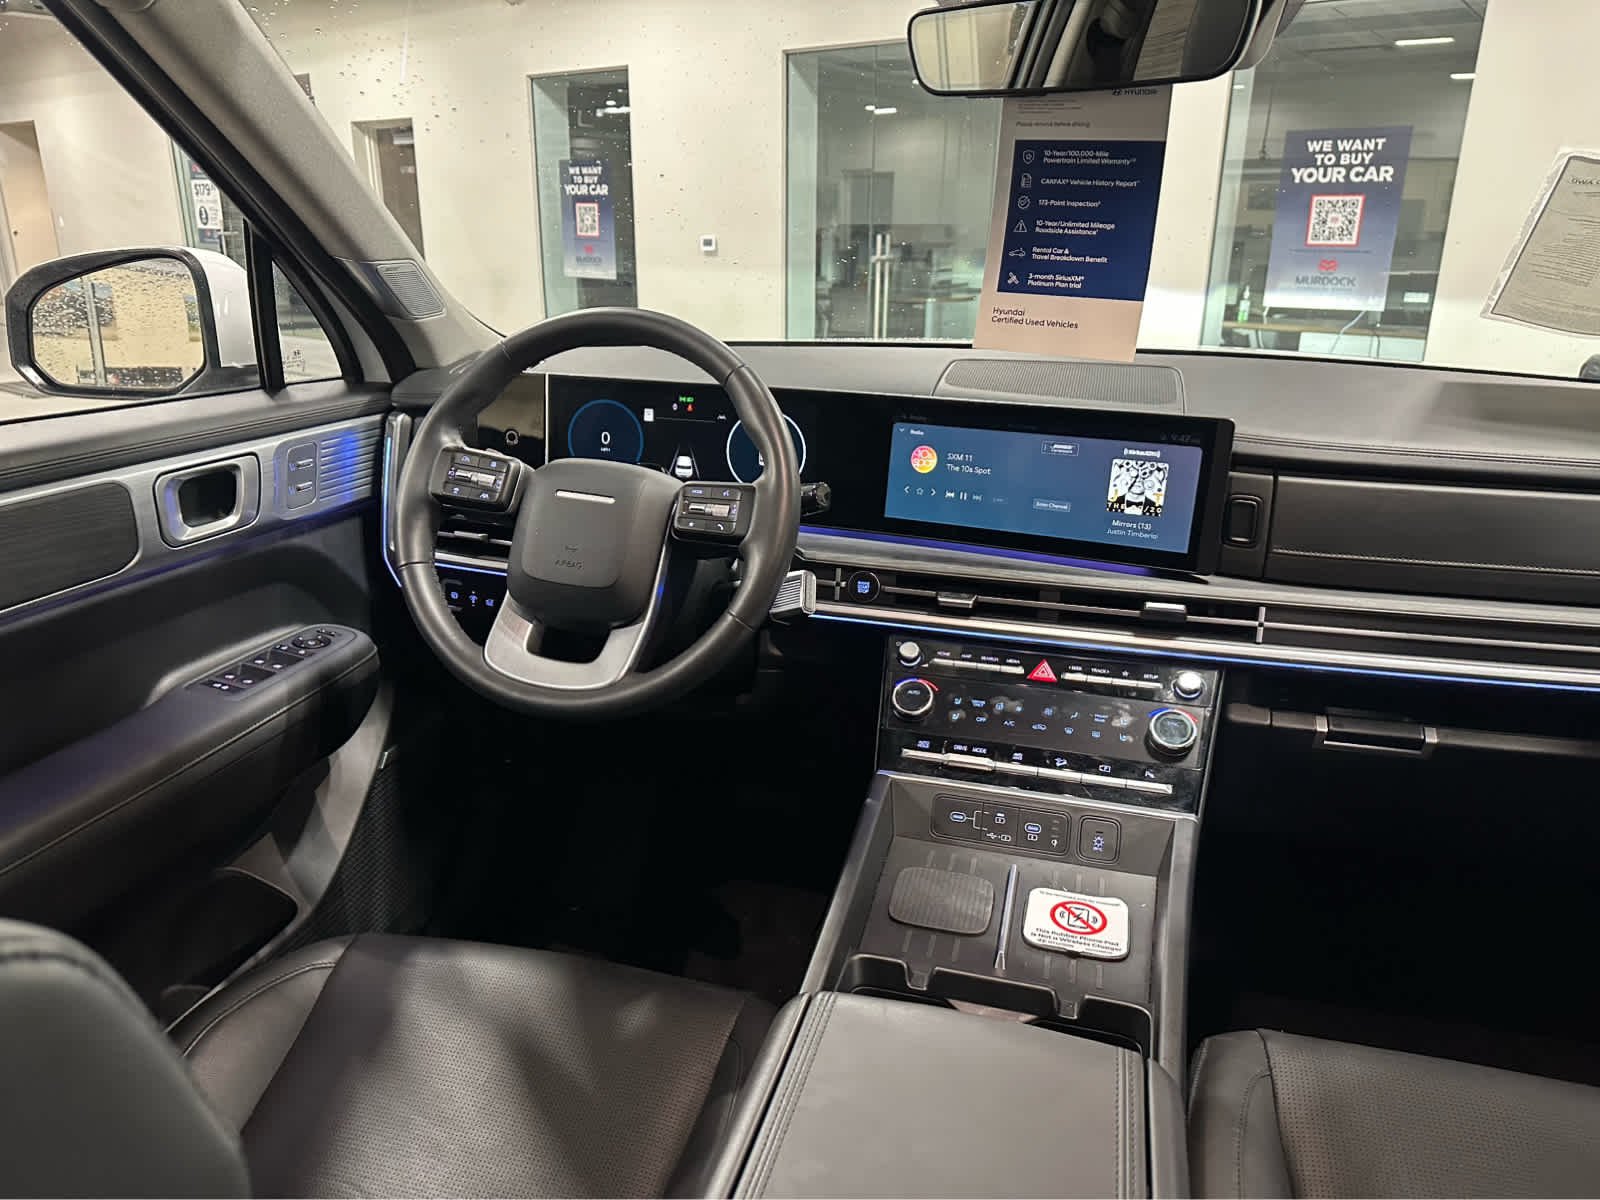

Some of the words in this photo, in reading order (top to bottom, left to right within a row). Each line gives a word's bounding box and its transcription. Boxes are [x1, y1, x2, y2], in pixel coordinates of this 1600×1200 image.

[1306, 139, 1333, 153] WE
[1337, 138, 1387, 152] WANT
[1314, 153, 1337, 166] TO
[1340, 152, 1374, 165] BUY
[568, 166, 581, 175] WE
[581, 166, 602, 175] WANT
[1290, 167, 1347, 184] YOUR
[1349, 165, 1394, 183] CAR
[573, 176, 583, 184] TO
[584, 176, 598, 184] BUY
[1070, 178, 1091, 186] Vehicle
[1092, 179, 1114, 187] History
[563, 184, 589, 196] YOUR
[589, 184, 609, 196] CAR
[1090, 222, 1116, 231] Mileage
[1295, 276, 1357, 287] MURDOCK
[992, 307, 1025, 317] Hyundai
[991, 316, 1024, 325] Certified
[1025, 318, 1045, 327] Used
[1046, 320, 1079, 329] Vehicles
[601, 432, 611, 445] 0
[946, 453, 963, 461] SXM
[946, 464, 960, 472] The
[973, 466, 992, 475] Spot
[1111, 520, 1137, 529] Mirrors
[1106, 528, 1126, 536] Justin
